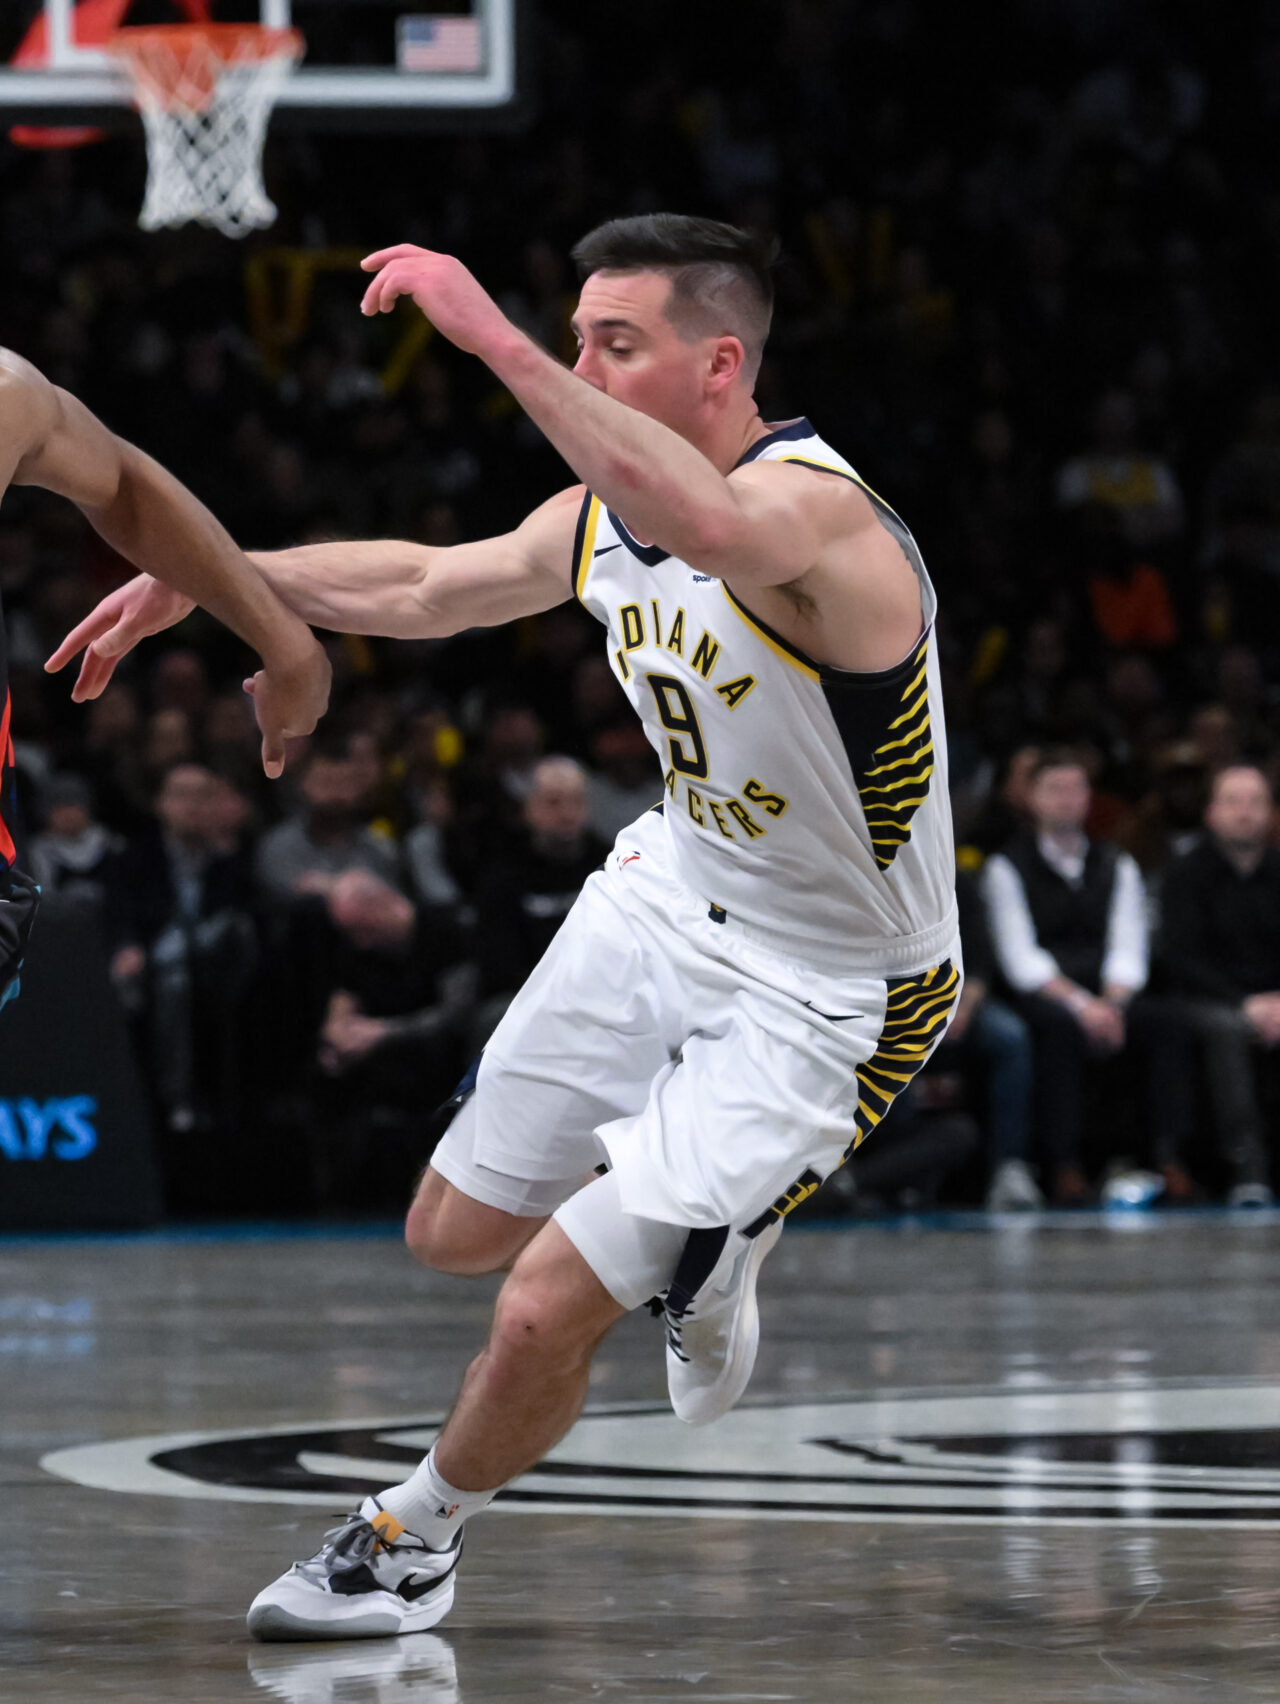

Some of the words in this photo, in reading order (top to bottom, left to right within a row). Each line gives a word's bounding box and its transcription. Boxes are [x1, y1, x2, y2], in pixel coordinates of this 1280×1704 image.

[615, 598, 759, 712] DIANA
[645, 672, 710, 781] 9
[665, 768, 789, 841] ACERS
